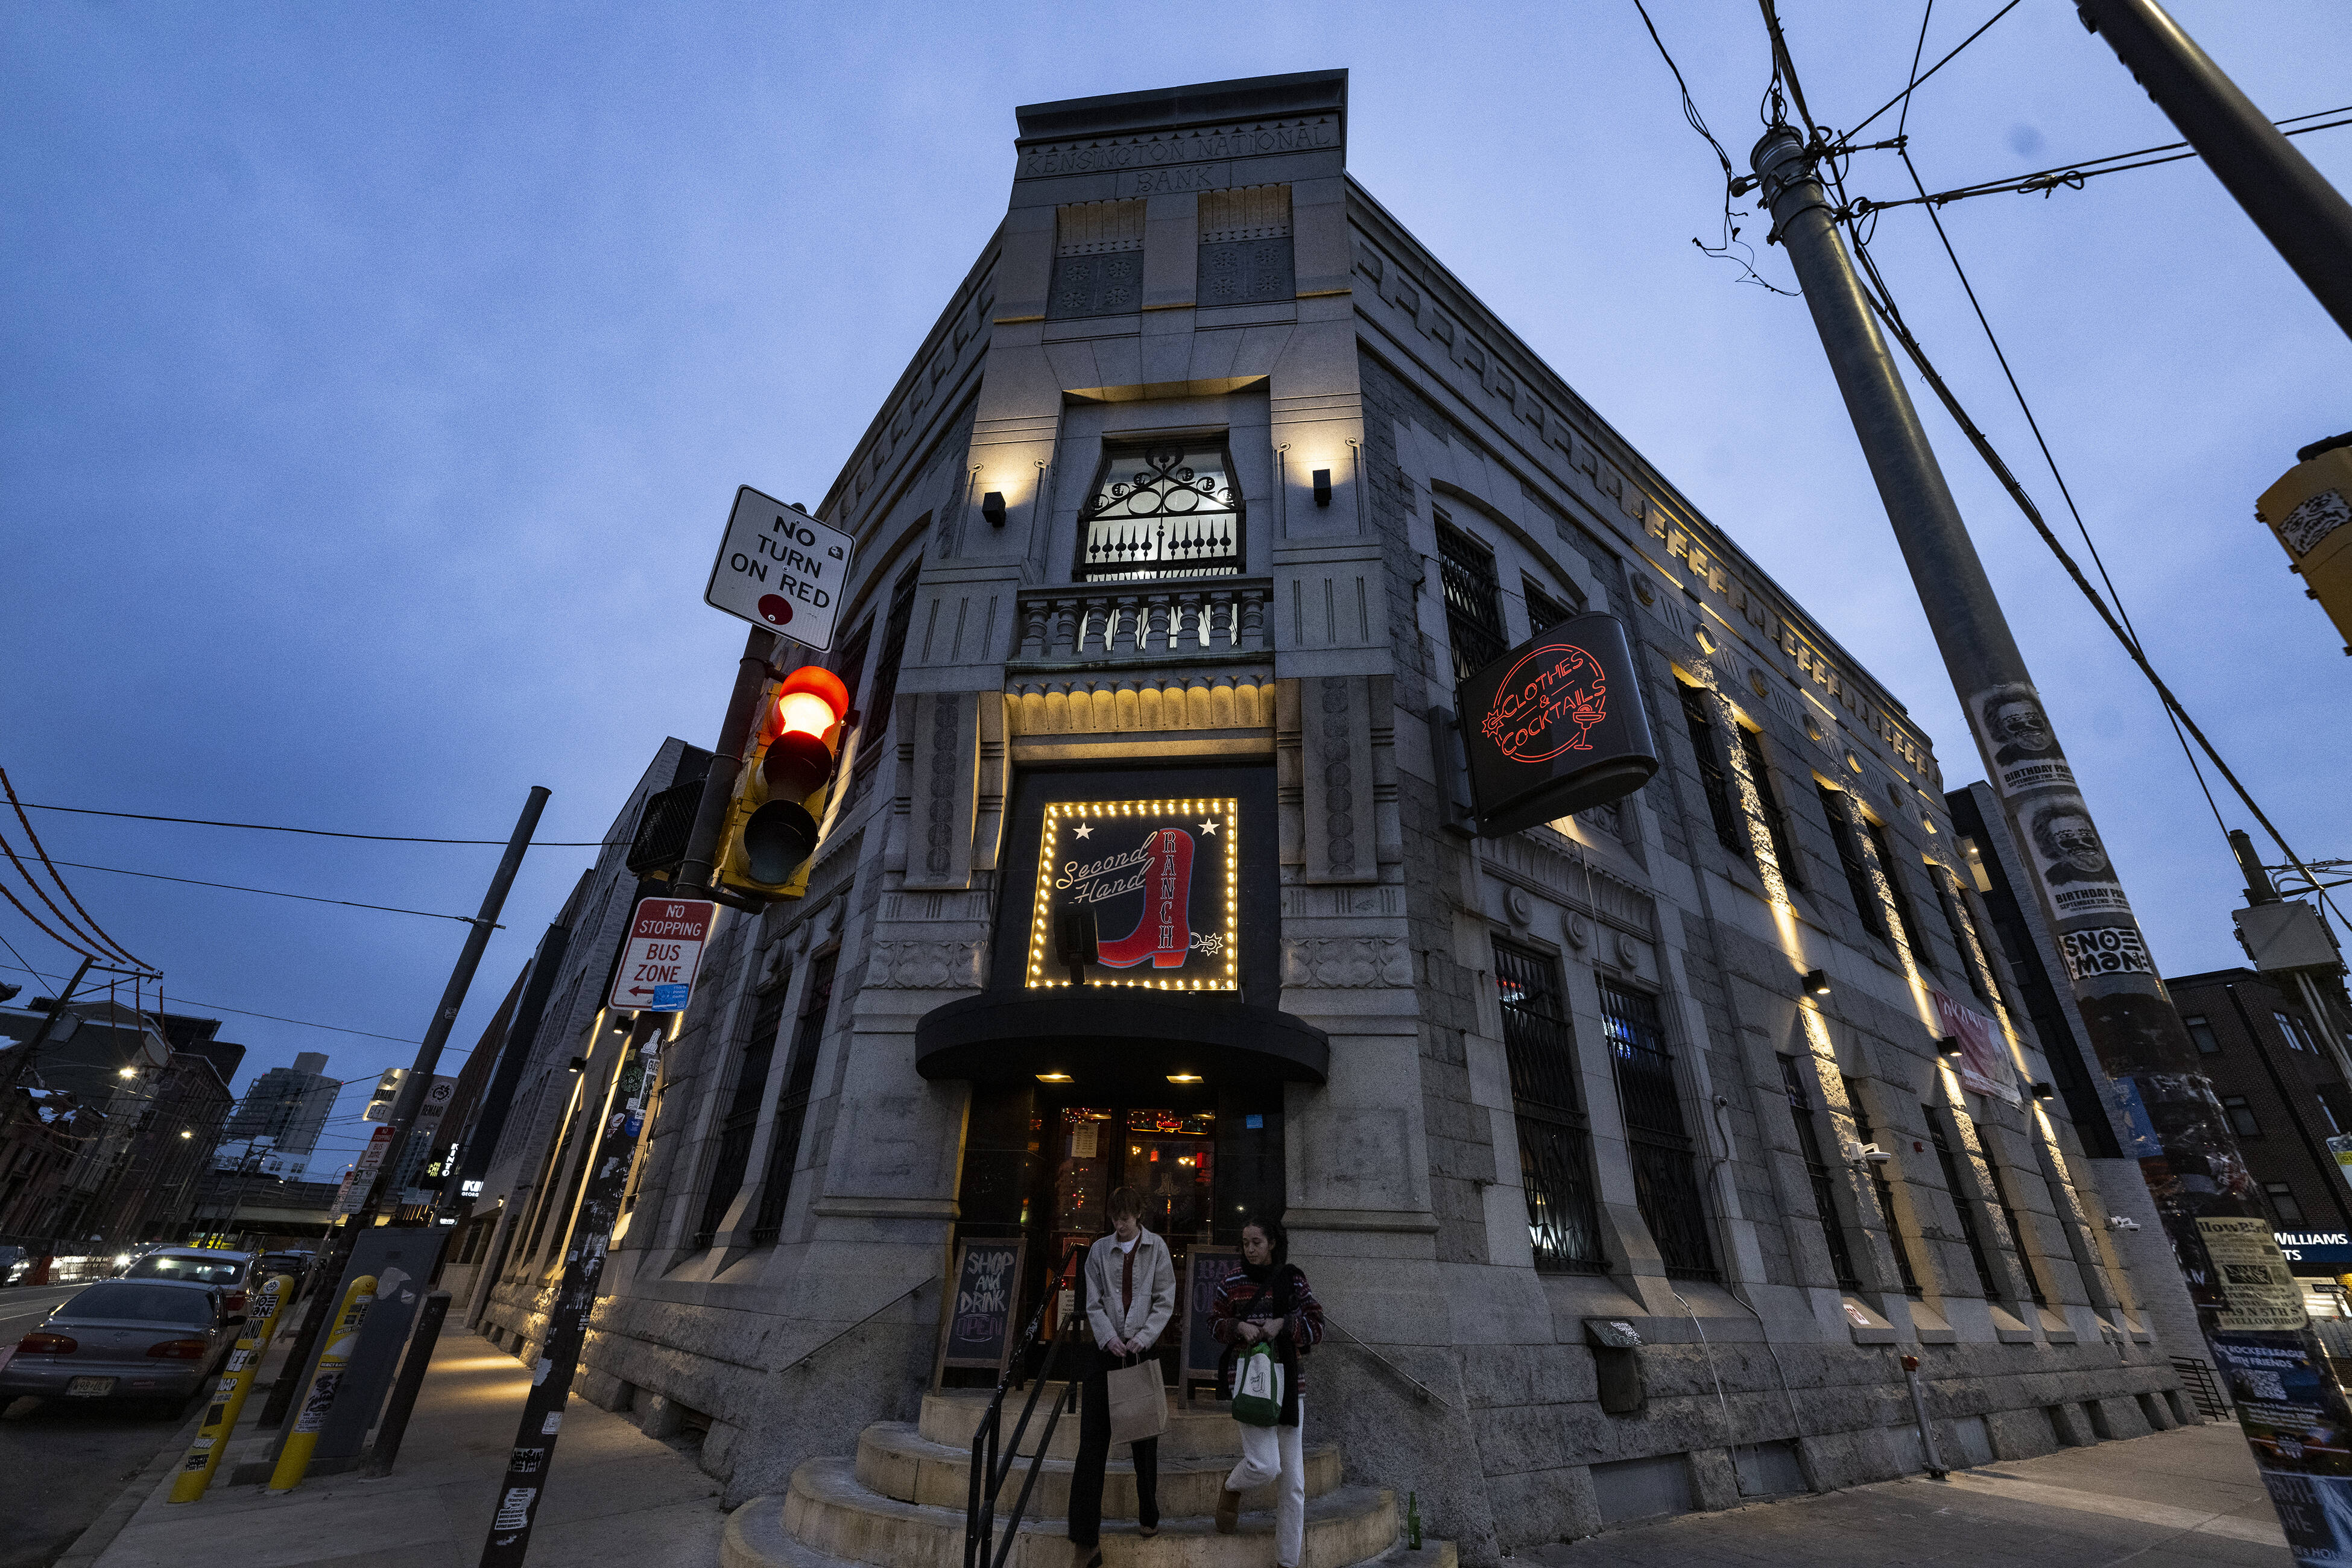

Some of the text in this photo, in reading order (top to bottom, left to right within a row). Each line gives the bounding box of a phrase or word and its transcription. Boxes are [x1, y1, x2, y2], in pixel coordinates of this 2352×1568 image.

[1025, 124, 1330, 175] KENSINGTON NATIONAL
[1137, 166, 1212, 192] BANK
[773, 516, 815, 546] NO
[758, 534, 822, 578] TURN
[730, 553, 829, 608] ON RED
[1502, 651, 1583, 716] CLOTHES
[1540, 695, 1550, 708] &
[1502, 679, 1605, 755] COCKTAILS
[2004, 765, 2052, 782] BIRTHDAY
[2008, 774, 2040, 788] SEPTEMBER
[1056, 831, 1158, 890] Second
[1069, 856, 1155, 904] Hand
[1158, 831, 1177, 949] RANCH
[2055, 888, 2109, 903] BIRTHDAY
[2060, 899, 2095, 909] SEPTEMBER
[666, 905, 685, 918] NO
[639, 920, 702, 936] STOPPING
[646, 943, 681, 961] BUS
[634, 964, 681, 982] ZONE
[420, 1104, 443, 1117] REMAND
[441, 1143, 459, 1177] KINTO
[2274, 1233, 2348, 1245] WILLIAMS
[967, 1251, 1014, 1275] SHOP
[958, 1290, 1007, 1314] DRINK
[2249, 1358, 2294, 1368] FRIENDS
